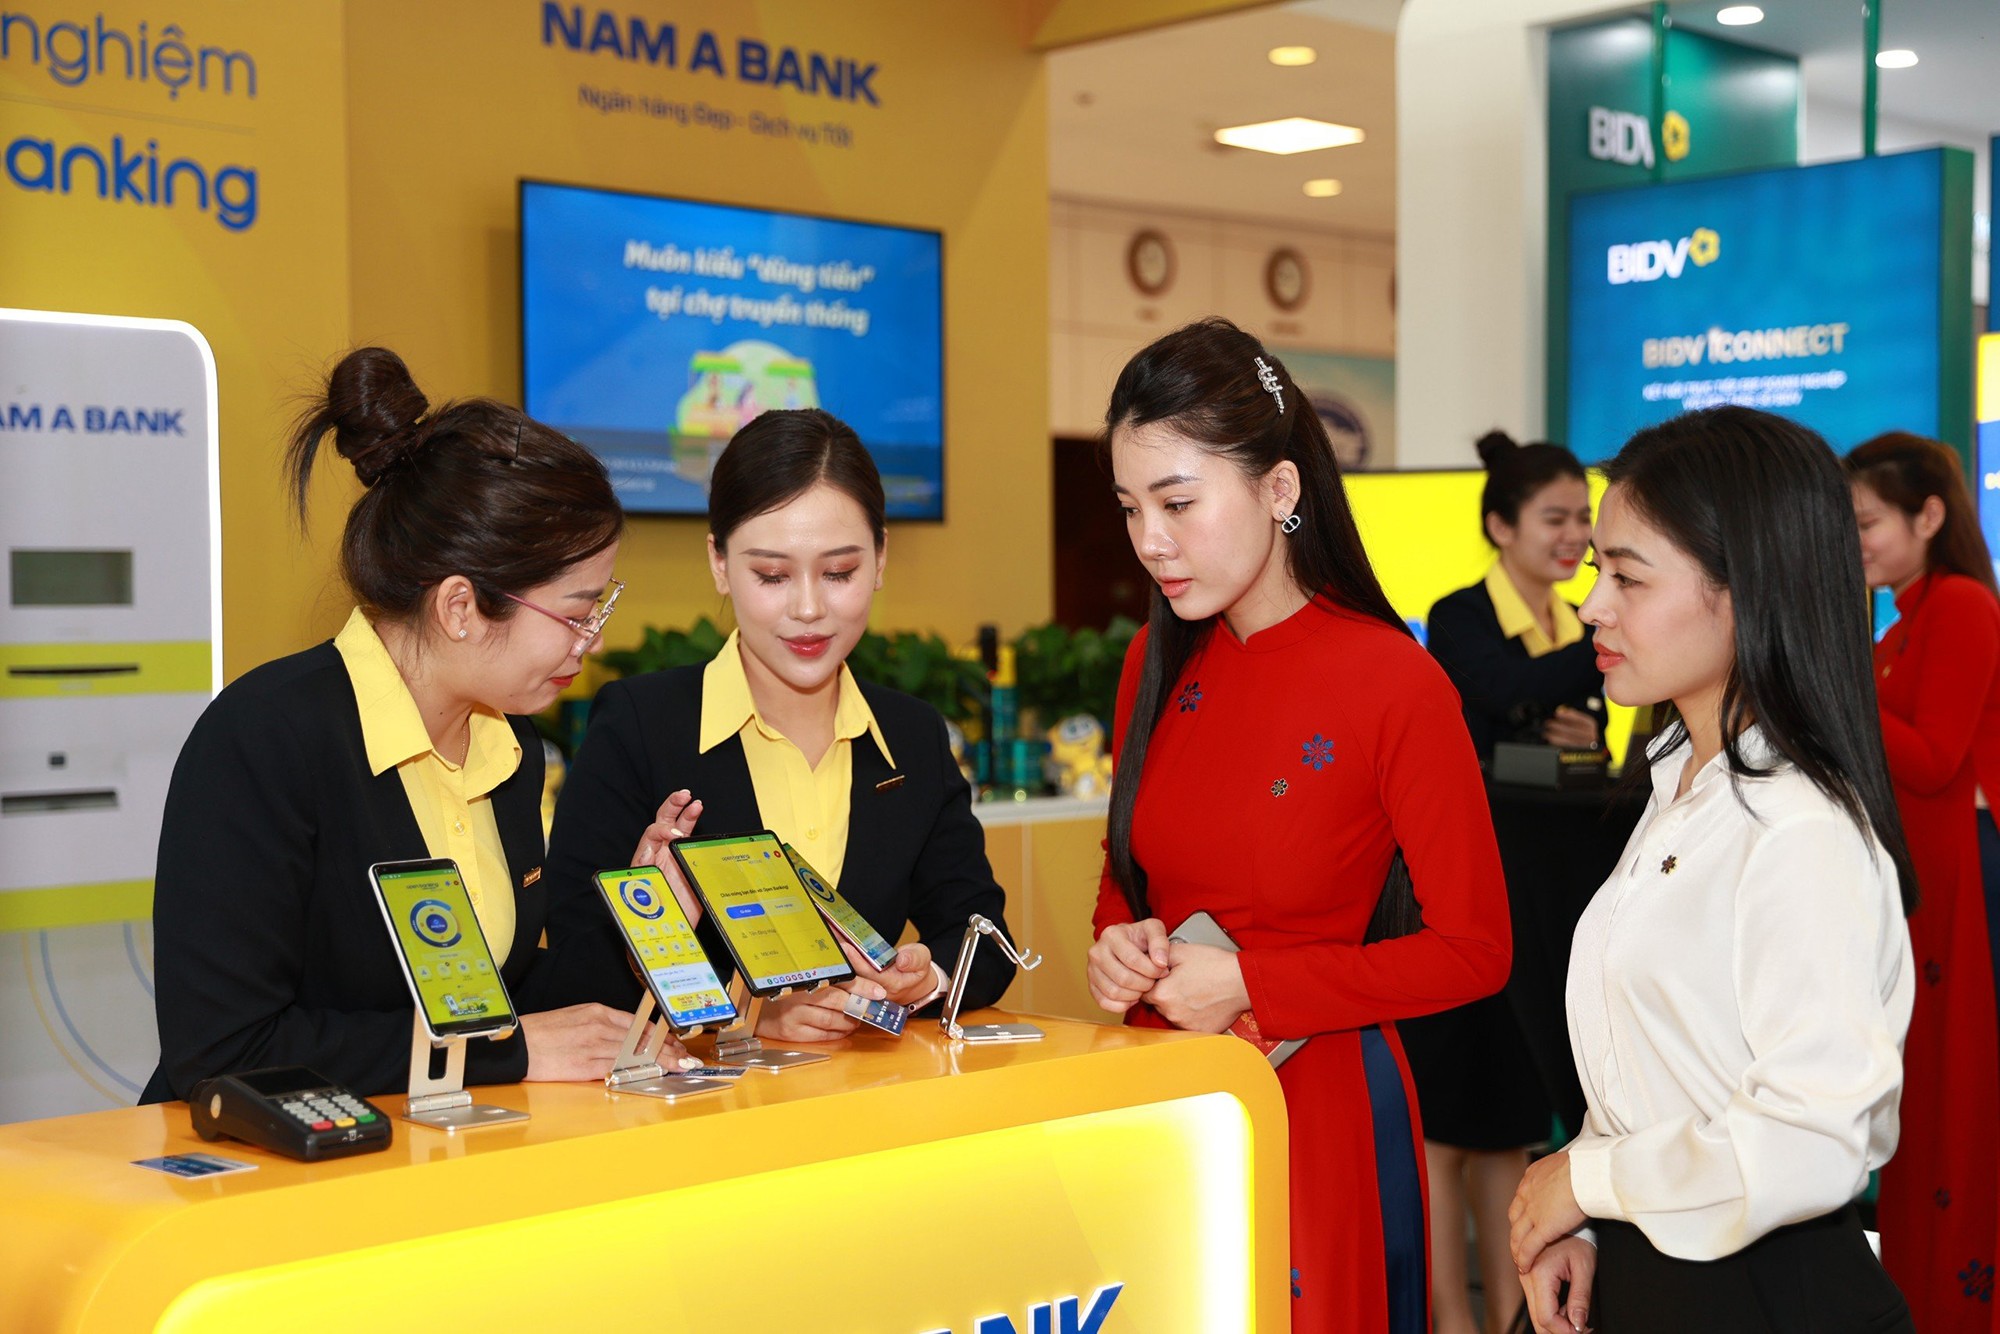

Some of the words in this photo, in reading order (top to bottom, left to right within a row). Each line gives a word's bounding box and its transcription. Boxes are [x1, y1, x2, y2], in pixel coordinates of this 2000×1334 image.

[1, 12, 257, 99] nghiệm
[541, 1, 677, 69] NAM
[689, 32, 725, 78] A
[736, 38, 882, 106] BANK
[0, 134, 258, 232] anking
[624, 240, 691, 274] Muôn
[1608, 237, 1691, 284] BIDV
[1642, 334, 1706, 368] BIDV
[52, 406, 75, 431] A
[85, 406, 184, 436] BANK
